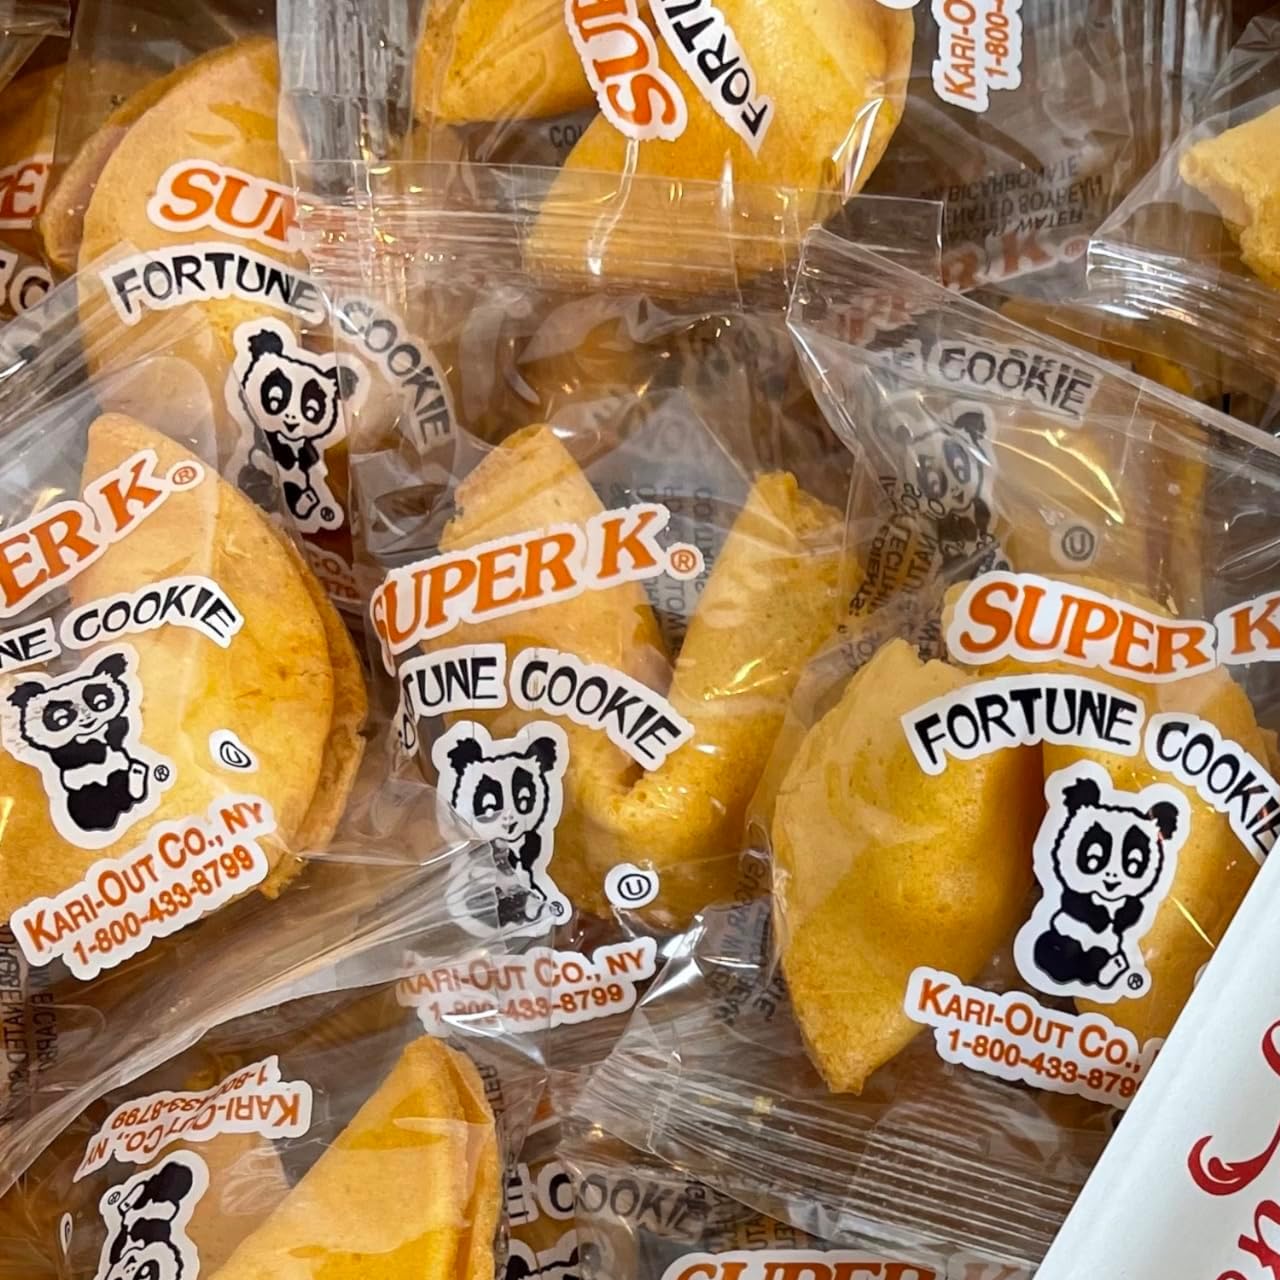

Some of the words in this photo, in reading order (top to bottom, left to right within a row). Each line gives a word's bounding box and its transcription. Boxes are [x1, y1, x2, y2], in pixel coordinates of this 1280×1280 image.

[112, 252, 321, 314] FORTUNE
[339, 301, 450, 445] COOKIE
[101, 459, 162, 528] K
[600, 512, 663, 577] K
[72, 583, 236, 643] COOKIE
[959, 583, 1213, 675] SUPER
[521, 660, 682, 760] COOKIE
[915, 688, 1138, 764] FORTUNE
[23, 855, 154, 953] KARI-OUT
[225, 803, 266, 832] NY
[73, 845, 254, 965] 1-800-433-8799
[606, 948, 645, 976] NY
[918, 979, 1077, 1046] KARI-OUT
